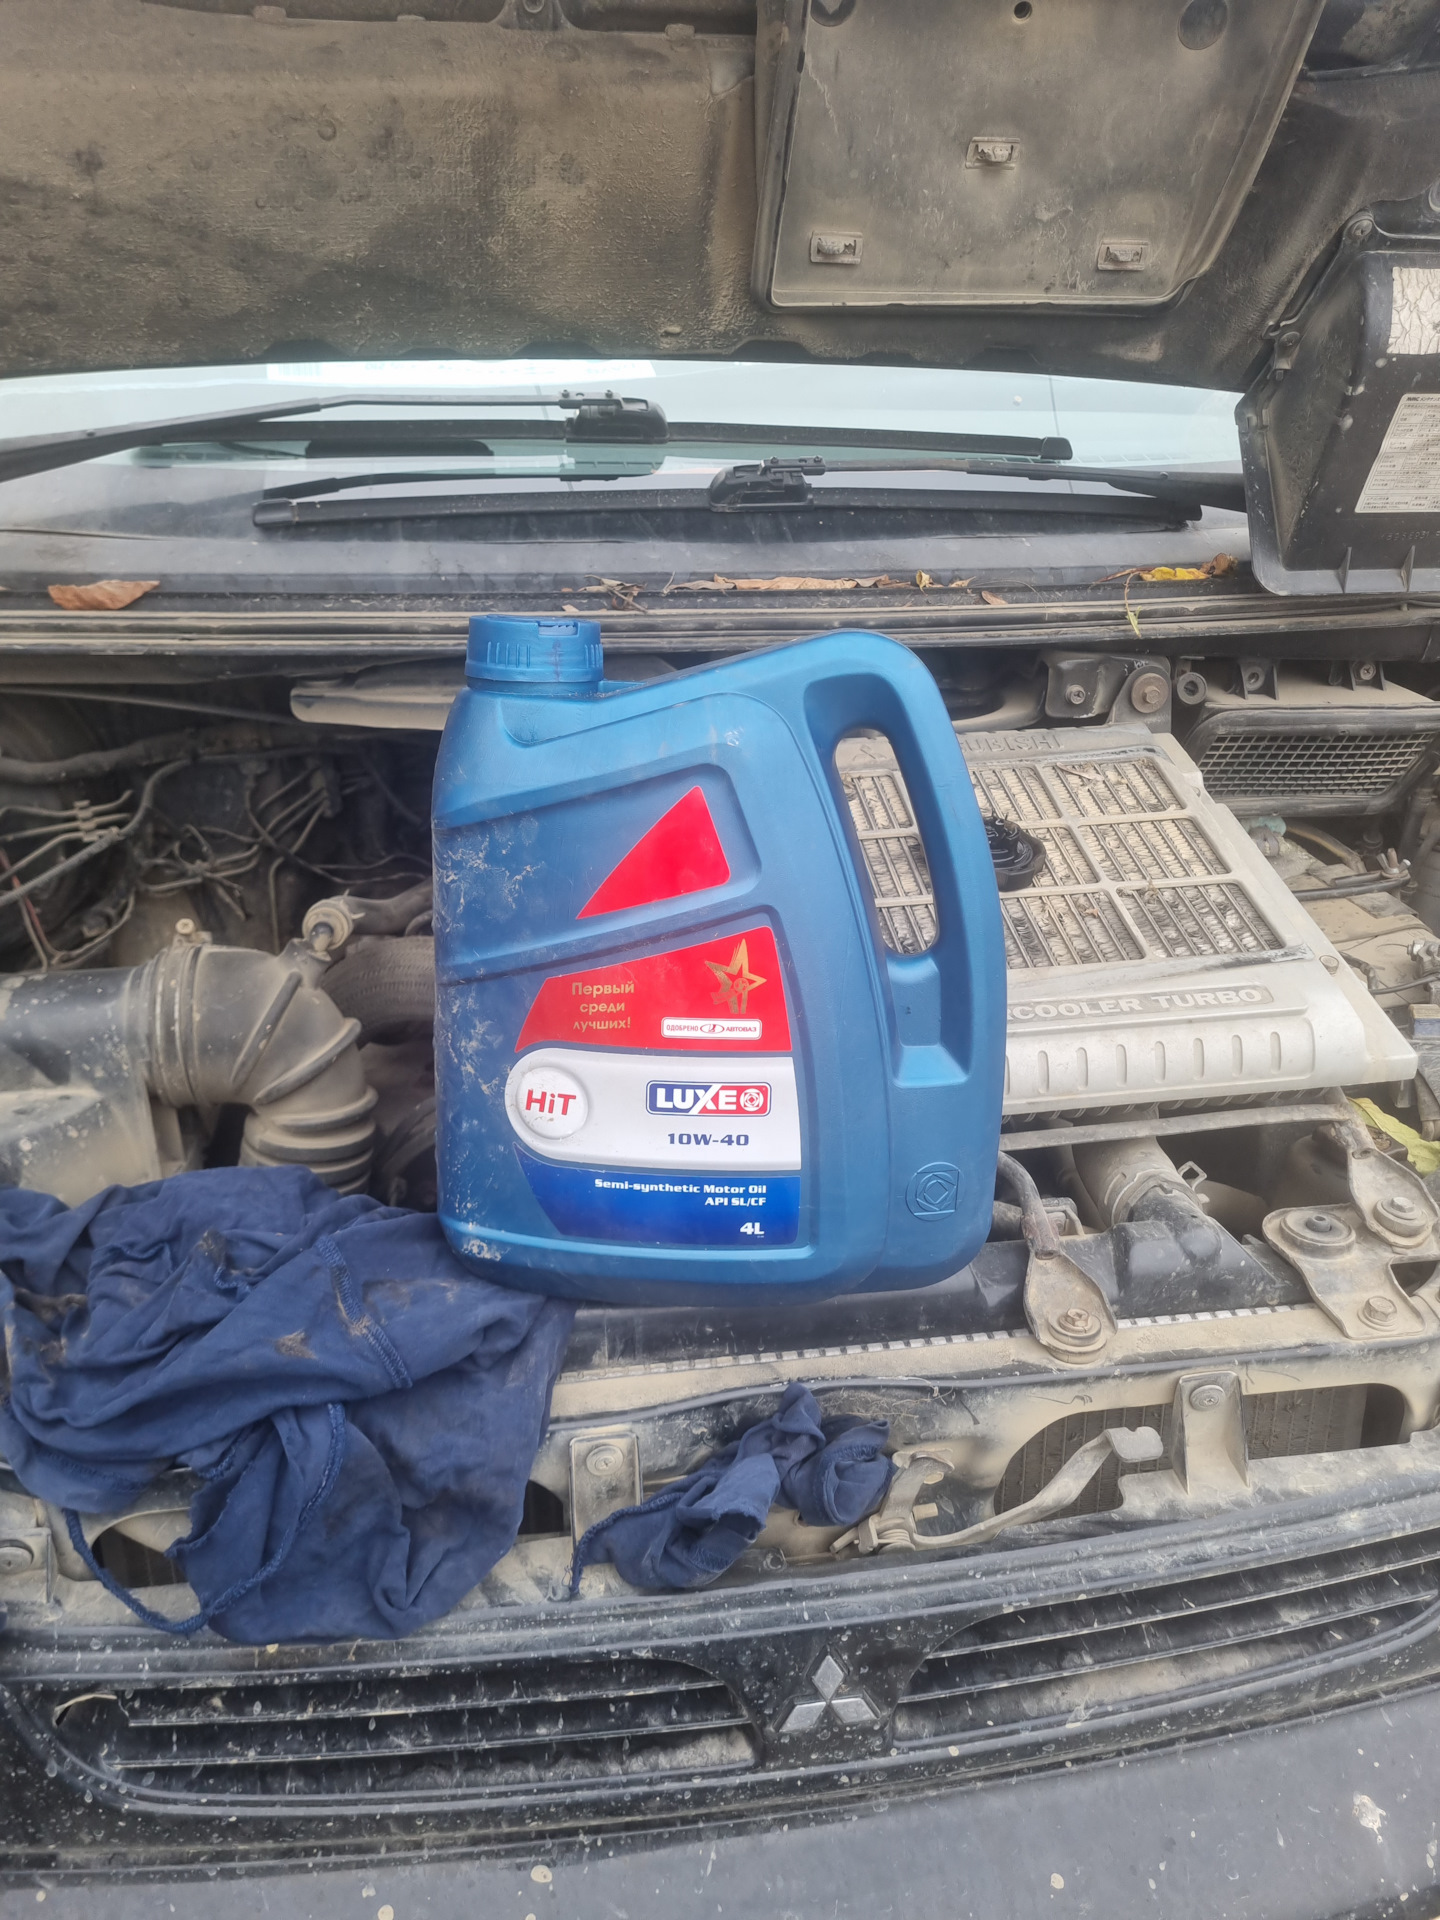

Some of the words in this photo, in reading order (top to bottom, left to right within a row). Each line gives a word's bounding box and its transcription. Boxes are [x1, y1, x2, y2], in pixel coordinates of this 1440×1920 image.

[572, 980, 635, 998] Первый
[1151, 988, 1262, 1010] TURBO
[580, 1000, 625, 1014] среди
[572, 1016, 632, 1031] лучших!
[666, 1024, 699, 1032] ОДОБРЕНО
[667, 1132, 750, 1147] 10W-40
[594, 1178, 701, 1193] Semi-synthetic
[703, 1184, 746, 1194] Motor
[748, 1185, 767, 1194] Oil
[704, 1197, 729, 1206] API
[731, 1197, 767, 1206] SL/CF
[739, 1222, 765, 1235] 4L
